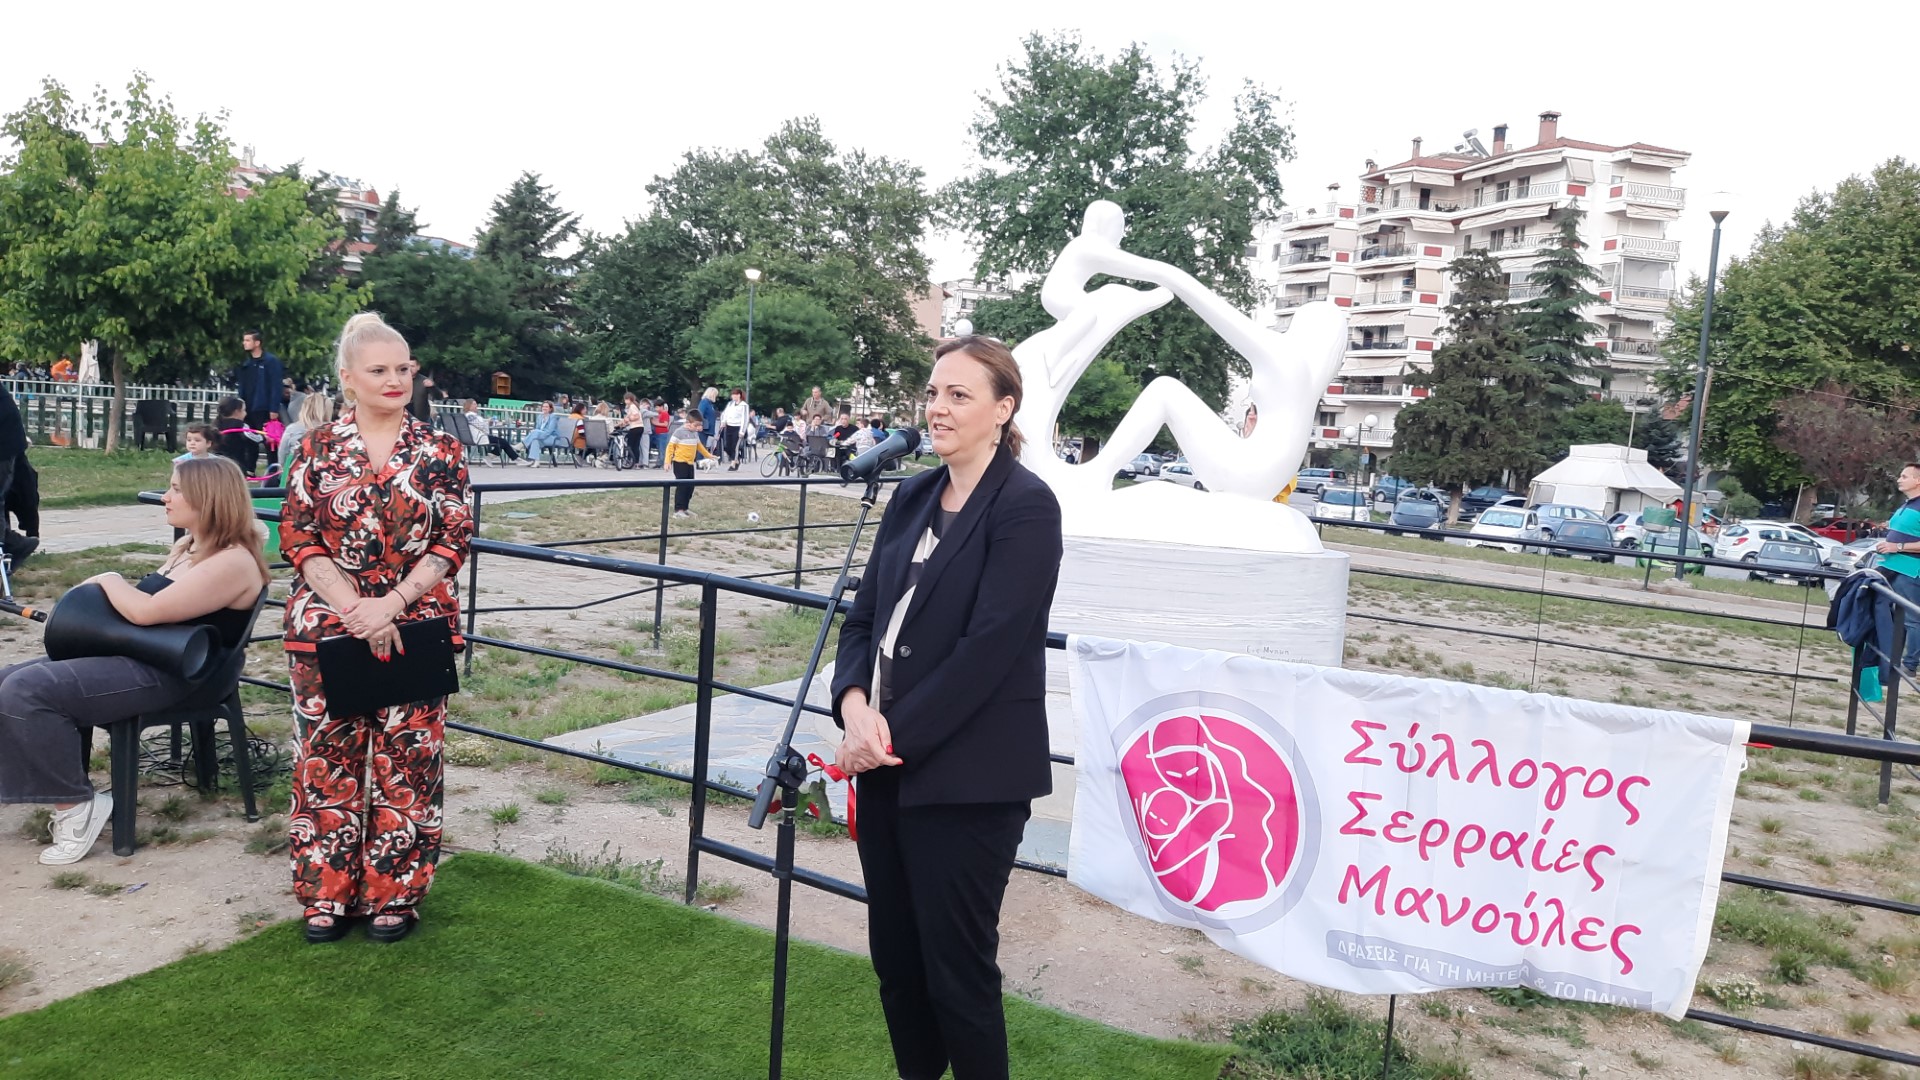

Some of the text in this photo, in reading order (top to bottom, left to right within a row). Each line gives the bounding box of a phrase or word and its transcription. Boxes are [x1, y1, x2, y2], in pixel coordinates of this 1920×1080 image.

[1344, 719, 1651, 825] Σύλλογος
[1339, 791, 1616, 892] Σερραίες
[1338, 864, 1642, 975] Μανούλες
[1338, 940, 1399, 962] ΔΡΑΣΕΙΣ
[1403, 953, 1430, 973] ΓΙΑ
[1437, 960, 1460, 981] ΤΗ
[1533, 977, 1547, 990] &
[1554, 981, 1577, 999] ΤΟ
